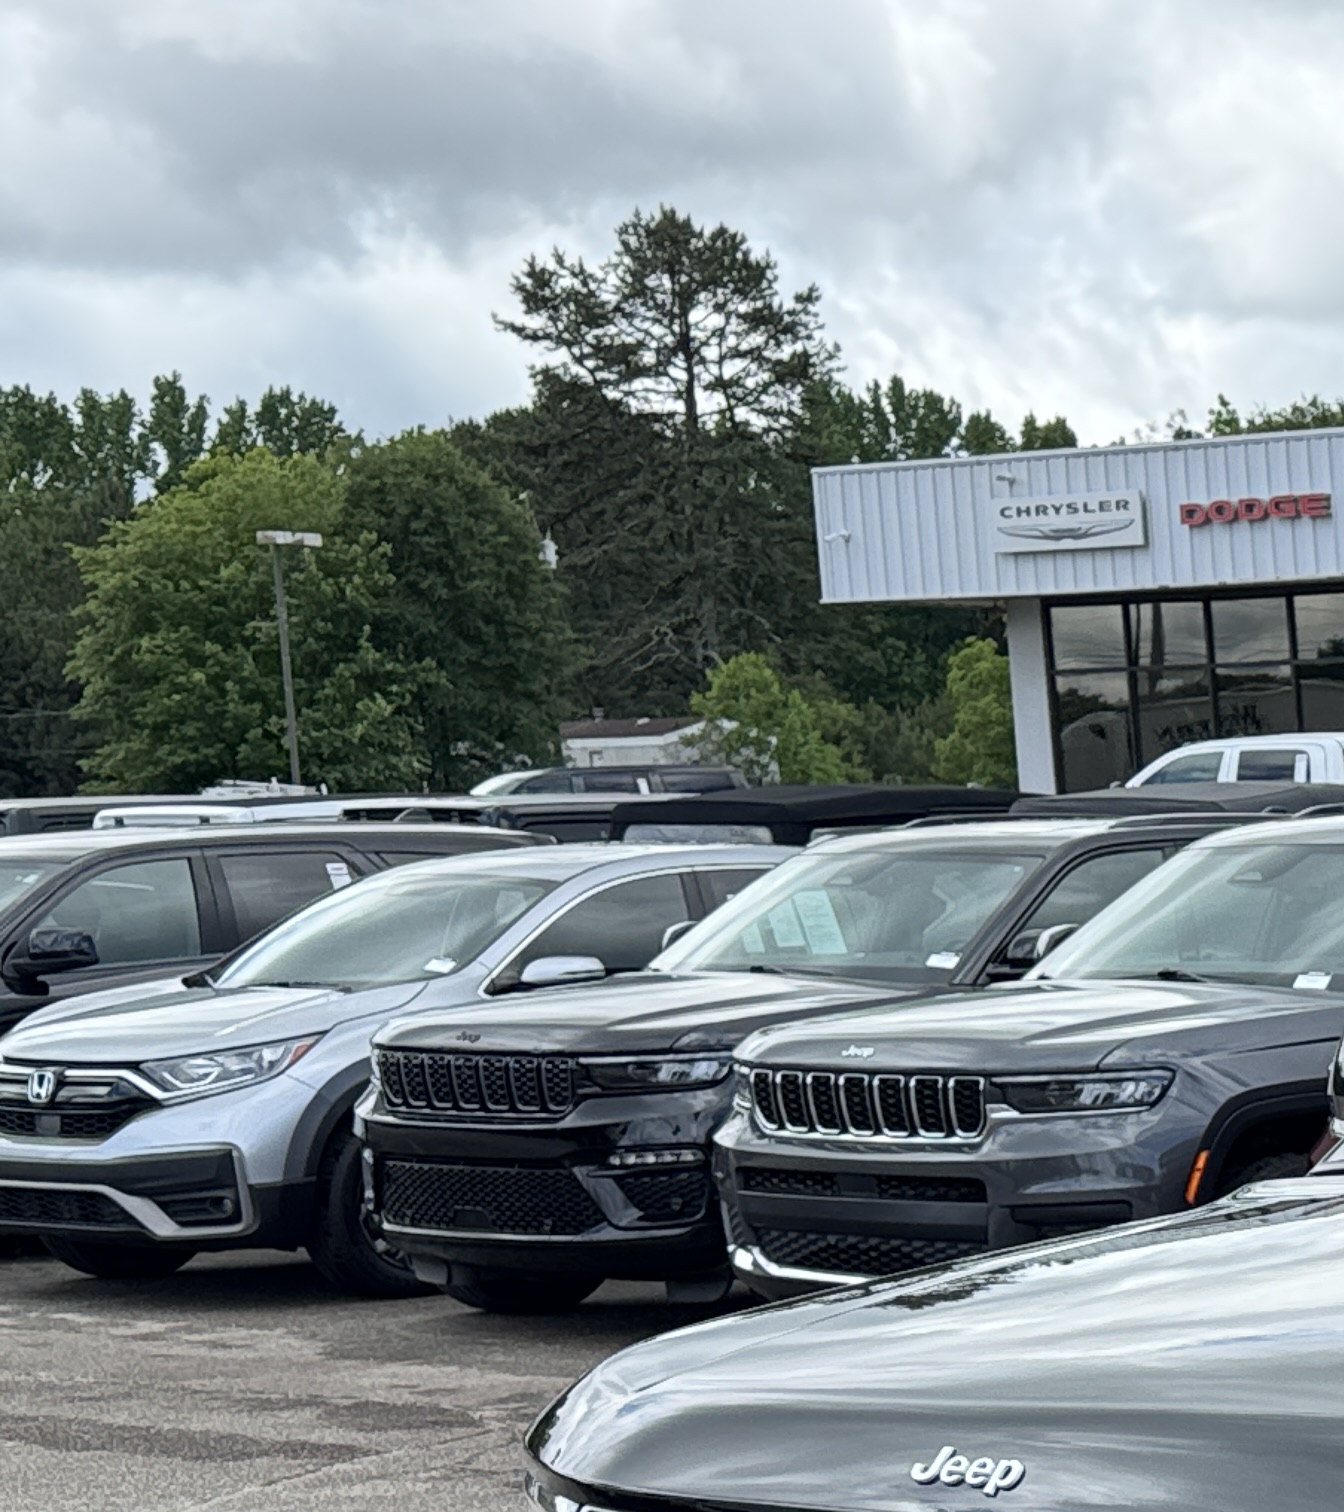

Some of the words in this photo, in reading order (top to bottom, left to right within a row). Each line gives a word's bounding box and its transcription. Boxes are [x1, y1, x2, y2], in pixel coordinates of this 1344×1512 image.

[999, 499, 1130, 519] CHRYSLER
[1179, 493, 1332, 527] DODGE
[909, 1445, 1026, 1497] Jeep
